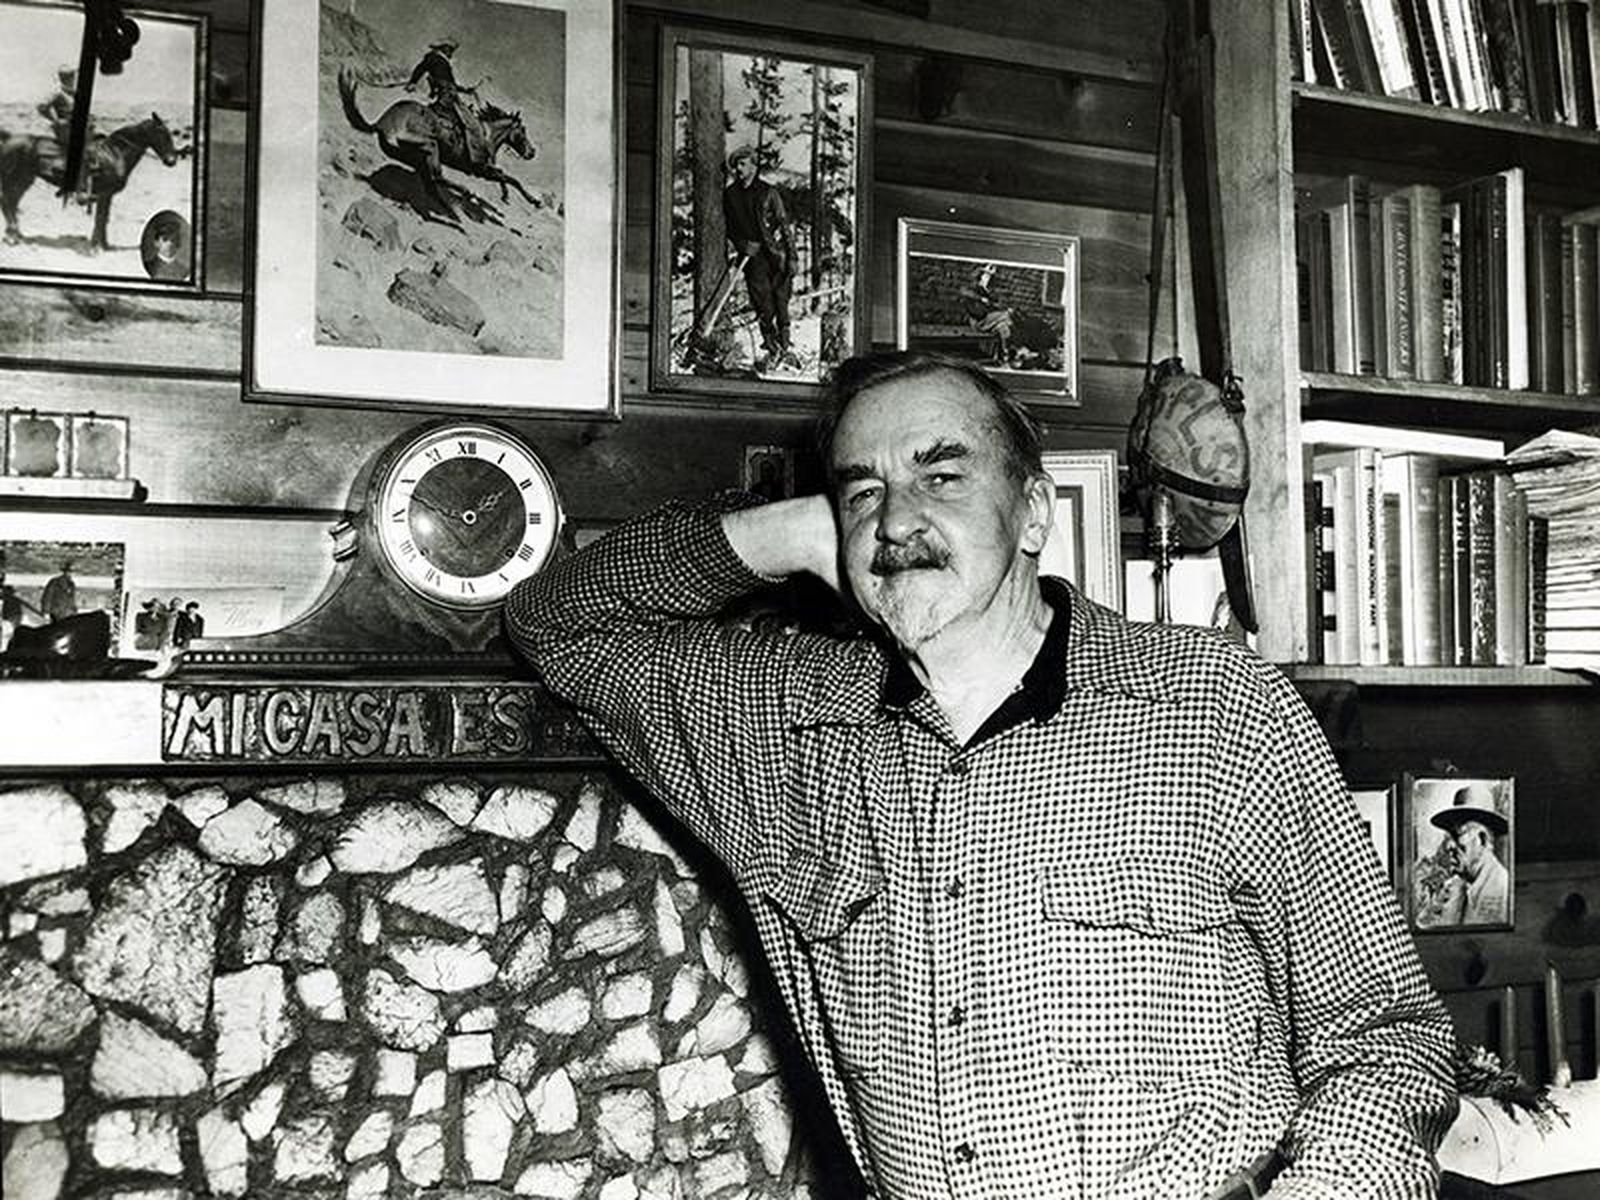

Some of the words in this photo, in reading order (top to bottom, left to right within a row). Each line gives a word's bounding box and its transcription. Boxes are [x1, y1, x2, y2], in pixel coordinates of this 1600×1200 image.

[168, 694, 245, 755] MI
[263, 690, 428, 756] CASA
[451, 691, 529, 754] ES
